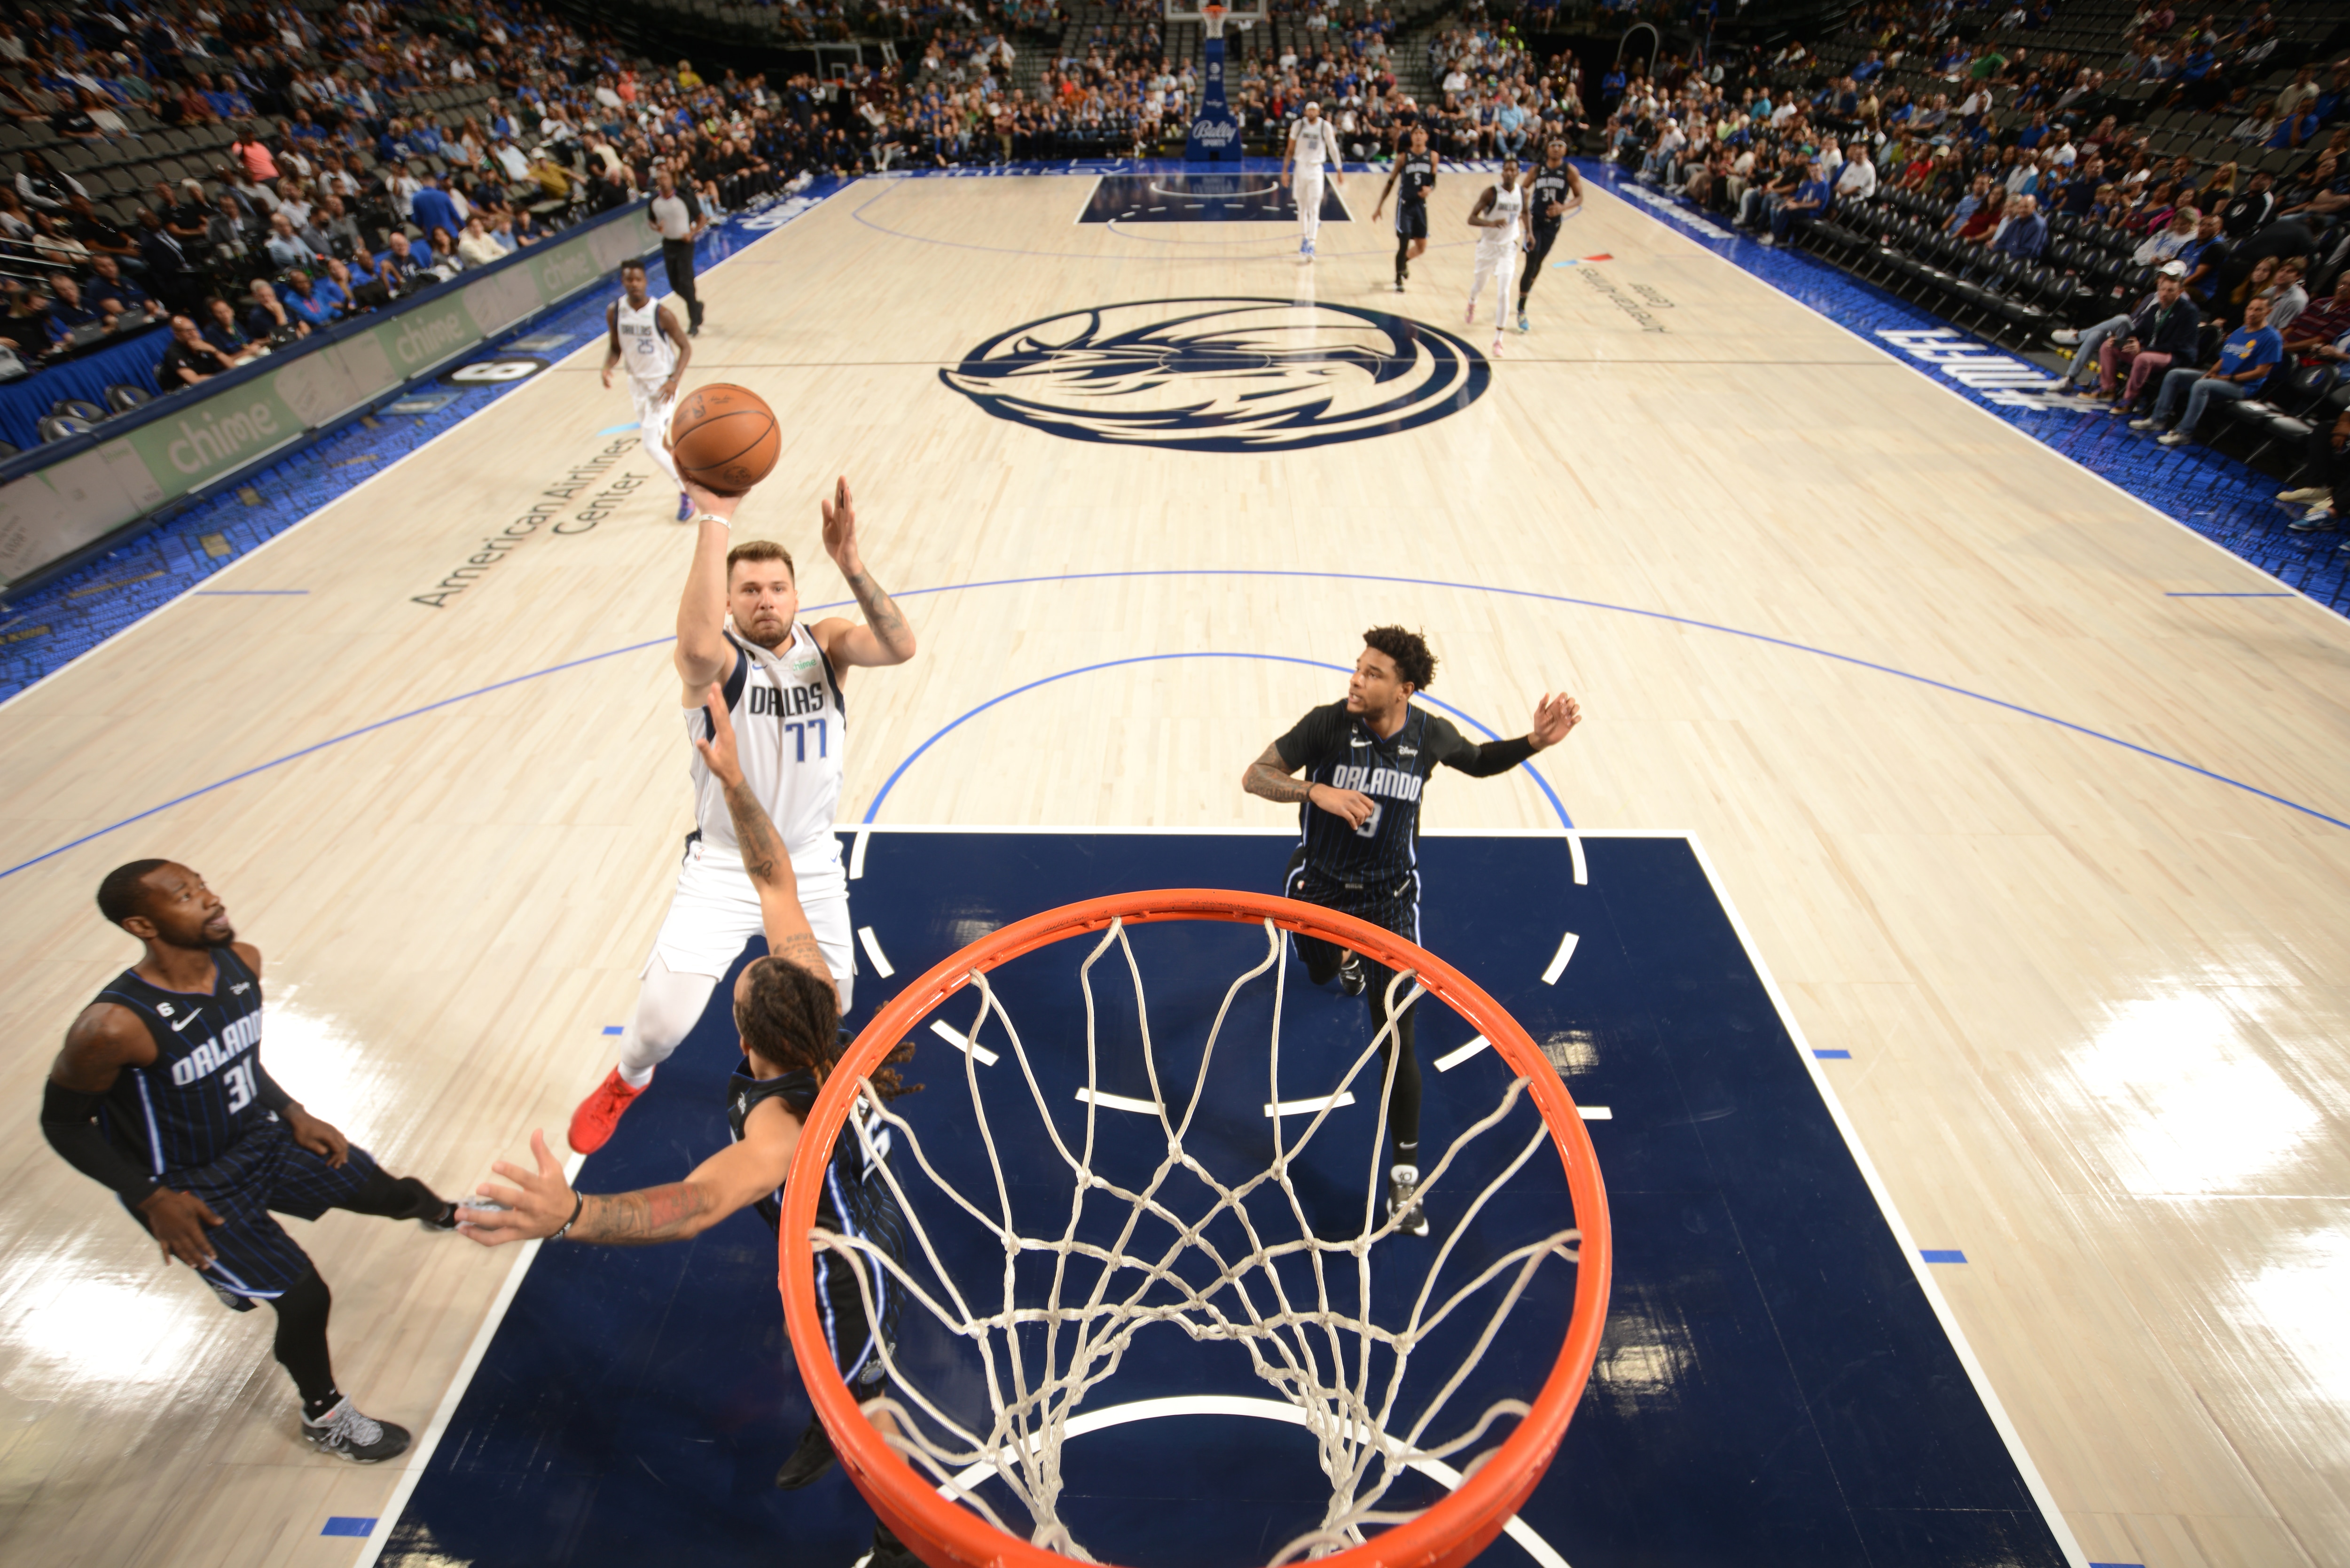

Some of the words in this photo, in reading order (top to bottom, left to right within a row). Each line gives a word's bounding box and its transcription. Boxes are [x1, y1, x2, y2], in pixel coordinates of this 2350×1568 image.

[1192, 120, 1236, 143] Bally
[1202, 139, 1226, 147] SPORTS
[1415, 172, 1422, 186] 5
[1536, 177, 1565, 189] ORLANDO
[1543, 189, 1556, 202] 34
[621, 324, 652, 335] DALLAS
[396, 313, 464, 364] chime
[637, 338, 653, 354] 25
[168, 402, 279, 475] chime
[552, 472, 648, 536] Center
[411, 496, 565, 608] American
[542, 436, 641, 499] Airlines
[2224, 537, 2259, 551] KIDD
[2260, 544, 2306, 562] JASON
[784, 718, 826, 763] 77
[1398, 745, 1418, 757] Disney
[1332, 764, 1423, 802] ORLANDO
[157, 1001, 175, 1018] 6
[223, 1055, 258, 1116] 31
